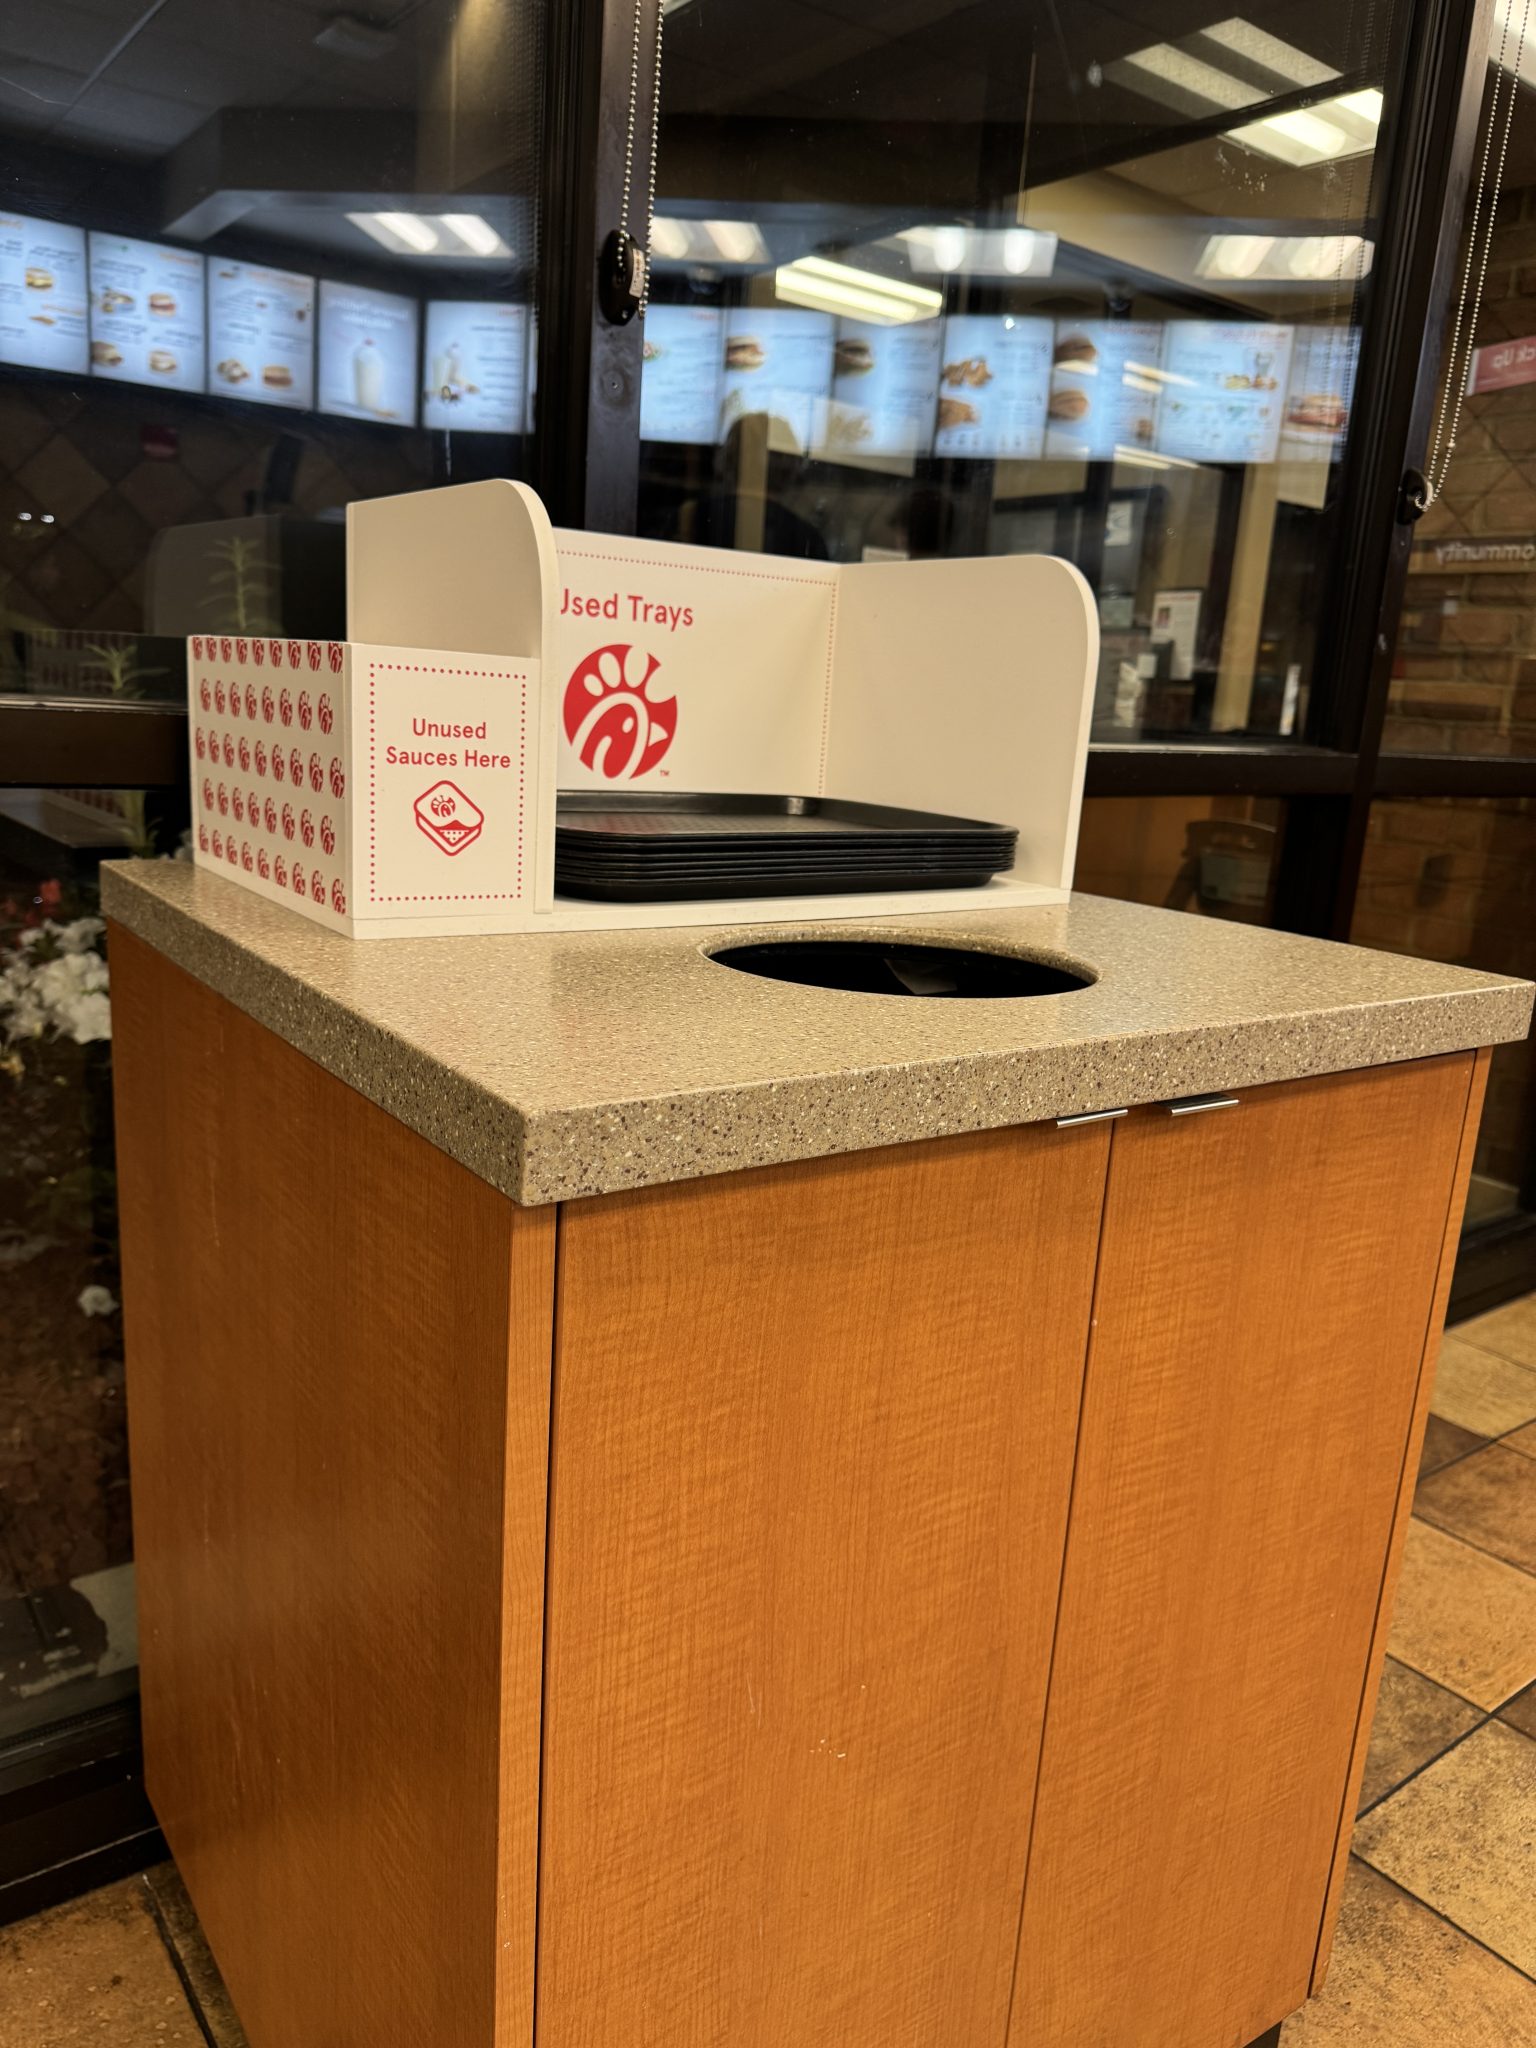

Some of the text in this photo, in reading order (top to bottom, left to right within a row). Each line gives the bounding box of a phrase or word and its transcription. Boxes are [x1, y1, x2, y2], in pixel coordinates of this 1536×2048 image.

[627, 595, 694, 632] Trays
[412, 717, 487, 740] Unused
[386, 745, 511, 769] Sauces Here
